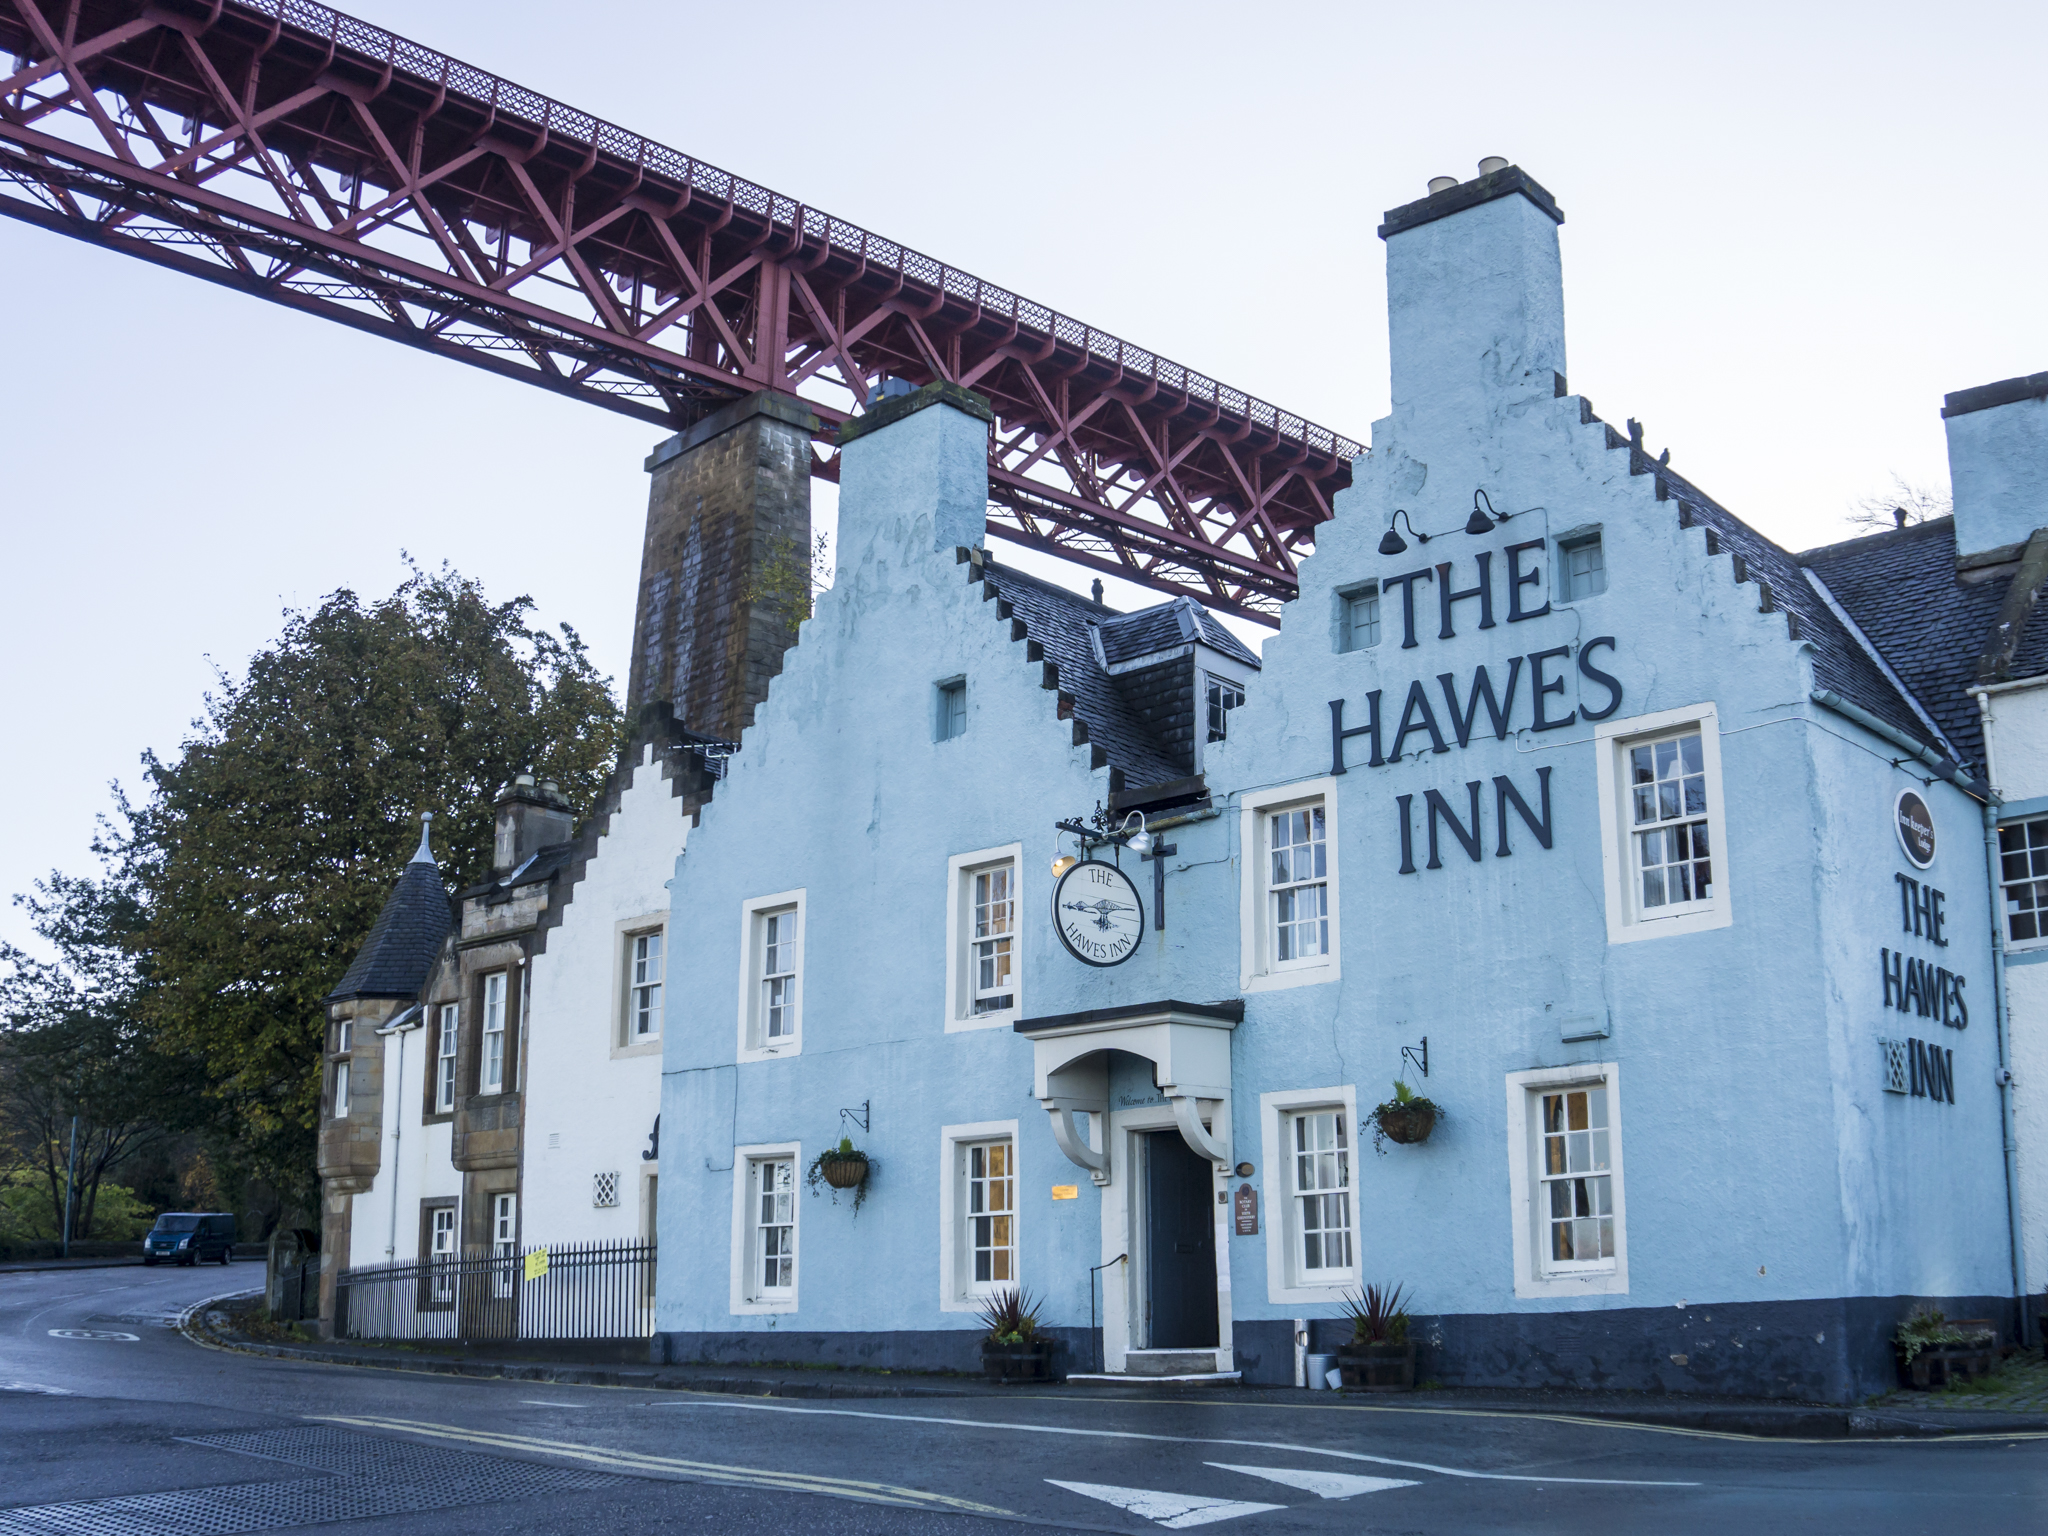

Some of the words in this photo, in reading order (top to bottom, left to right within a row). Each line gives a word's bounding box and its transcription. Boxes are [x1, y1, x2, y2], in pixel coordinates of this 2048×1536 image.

[1382, 536, 1552, 650] THE
[1327, 636, 1624, 777] HAWES
[1395, 765, 1553, 876] INN
[1088, 868, 1113, 887] THE
[1895, 871, 1949, 948] THE
[1066, 922, 1107, 958] HAWES
[1109, 933, 1131, 958] INN
[1881, 947, 1968, 1030] HAWES
[1119, 1094, 1145, 1106] Welcome
[1908, 1037, 1956, 1105] INN
